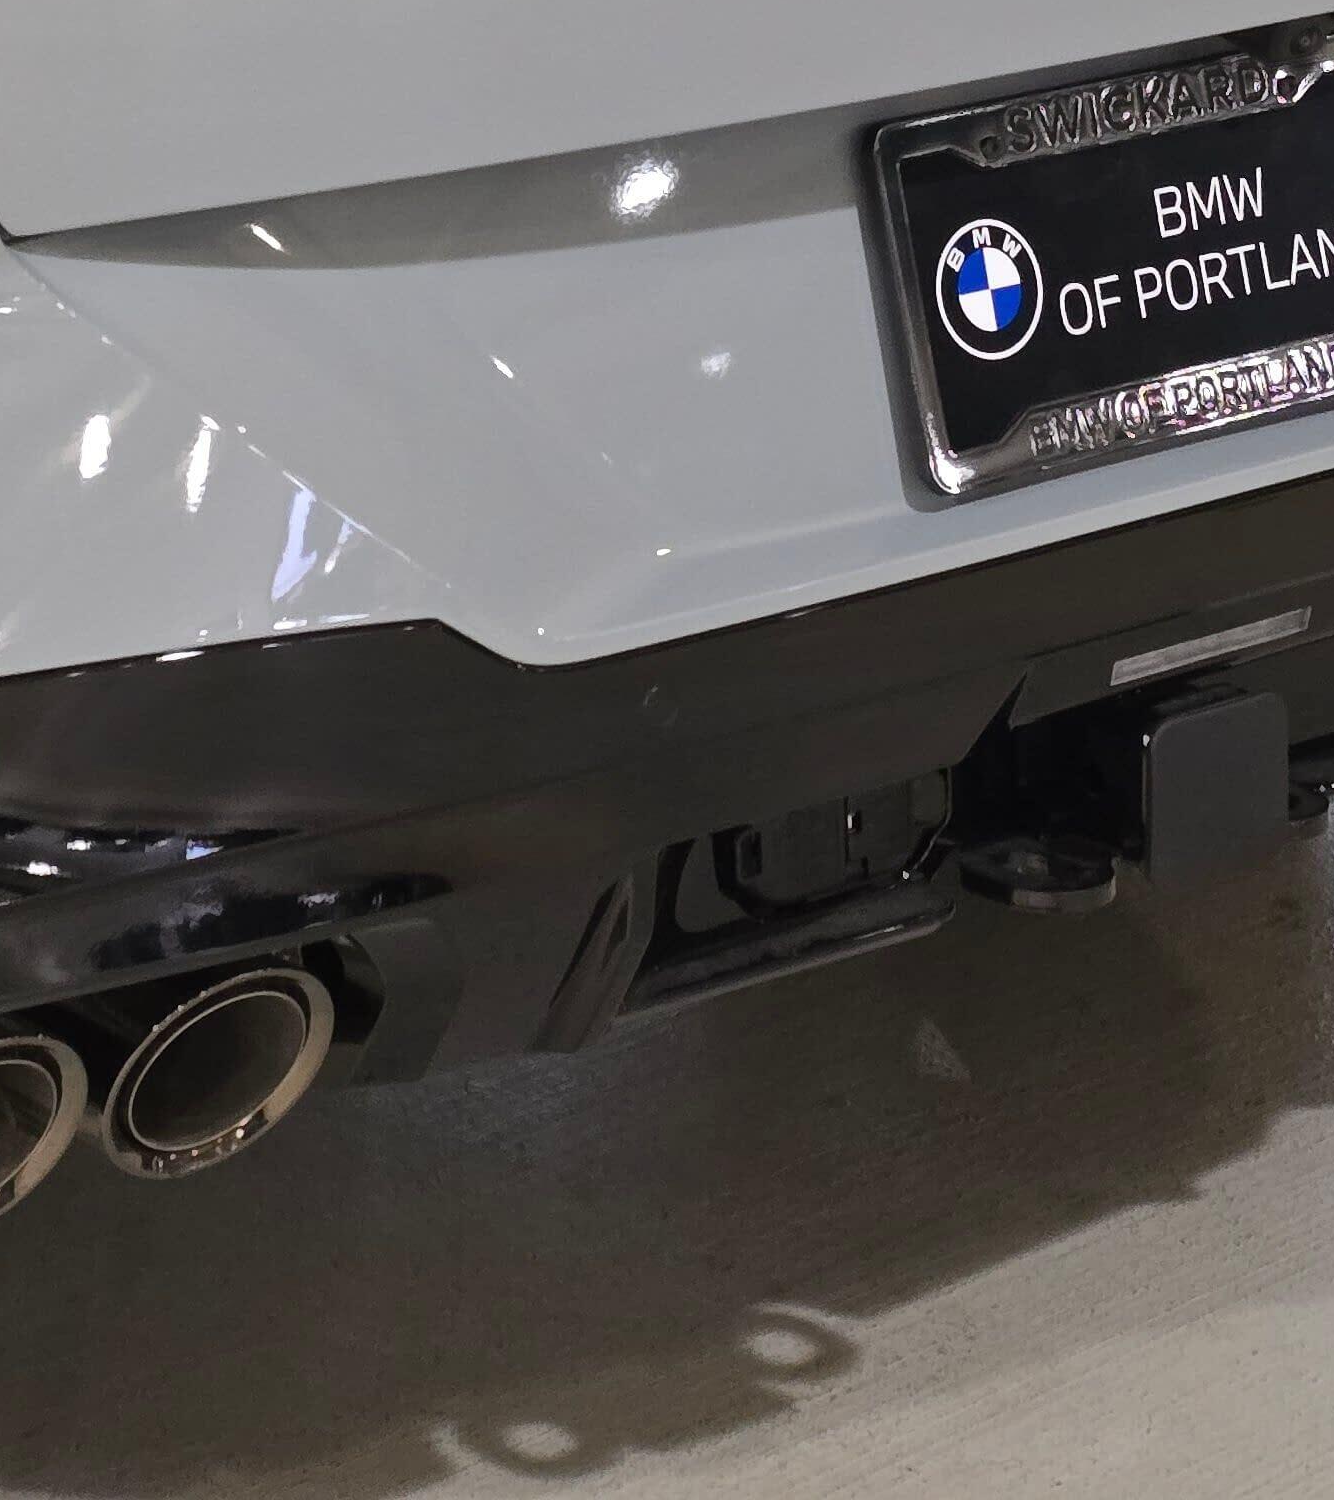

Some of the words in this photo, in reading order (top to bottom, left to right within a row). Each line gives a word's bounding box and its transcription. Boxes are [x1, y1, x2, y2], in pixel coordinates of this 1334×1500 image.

[1003, 55, 1269, 154] SWICKARD
[1154, 167, 1263, 239] BMW
[945, 226, 1023, 273] BMW
[1059, 274, 1122, 336] OF
